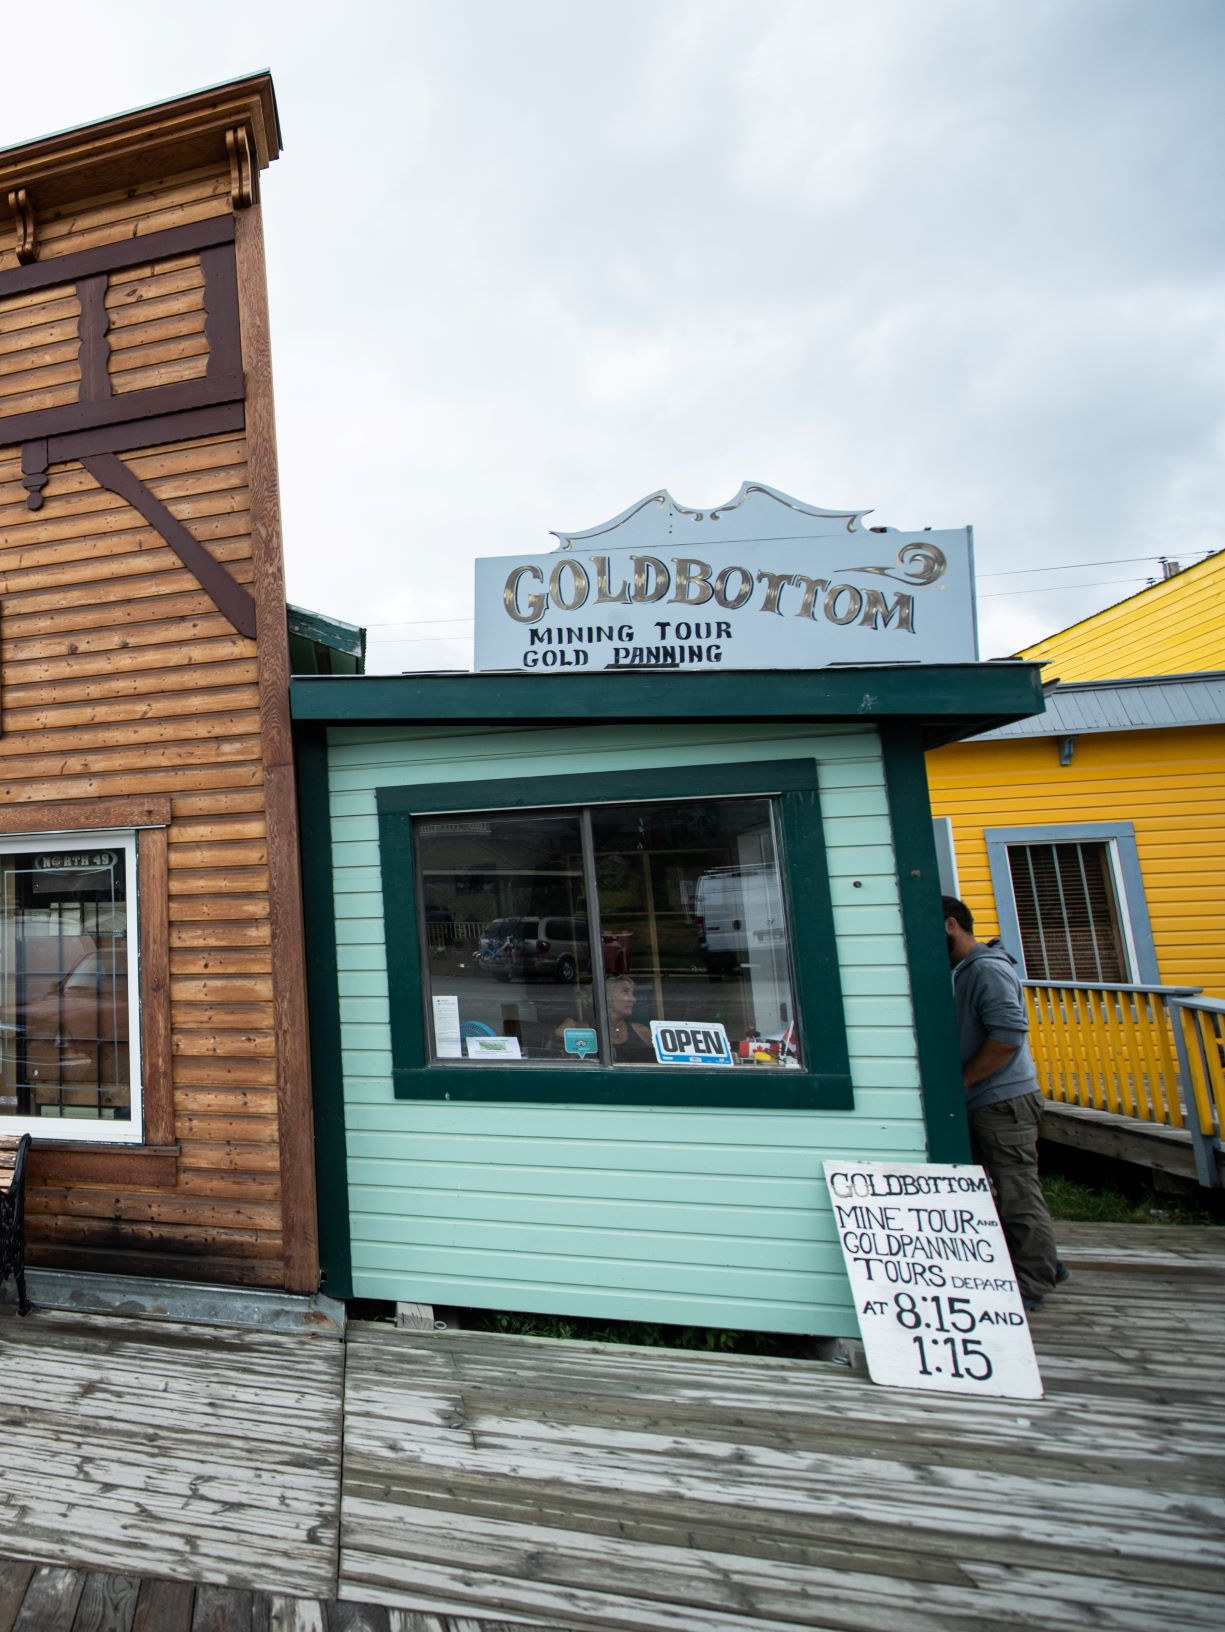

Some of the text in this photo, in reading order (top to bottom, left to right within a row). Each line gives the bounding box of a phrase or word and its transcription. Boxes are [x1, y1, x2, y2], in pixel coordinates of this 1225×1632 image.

[503, 554, 916, 634] GOLDBOTTOM
[529, 621, 733, 647] MINING TOUR
[523, 645, 723, 668] GOLD PANNING
[660, 1028, 725, 1055] OPEN
[830, 1172, 989, 1198] GOLDBOTTOM
[835, 1205, 999, 1234] MINE TOUR AND
[843, 1231, 995, 1263] GOLDPANNING
[853, 1257, 1016, 1292] TOURS DEPART
[862, 1292, 1024, 1334] AT 8:15 AND
[913, 1336, 993, 1380] 1:15
